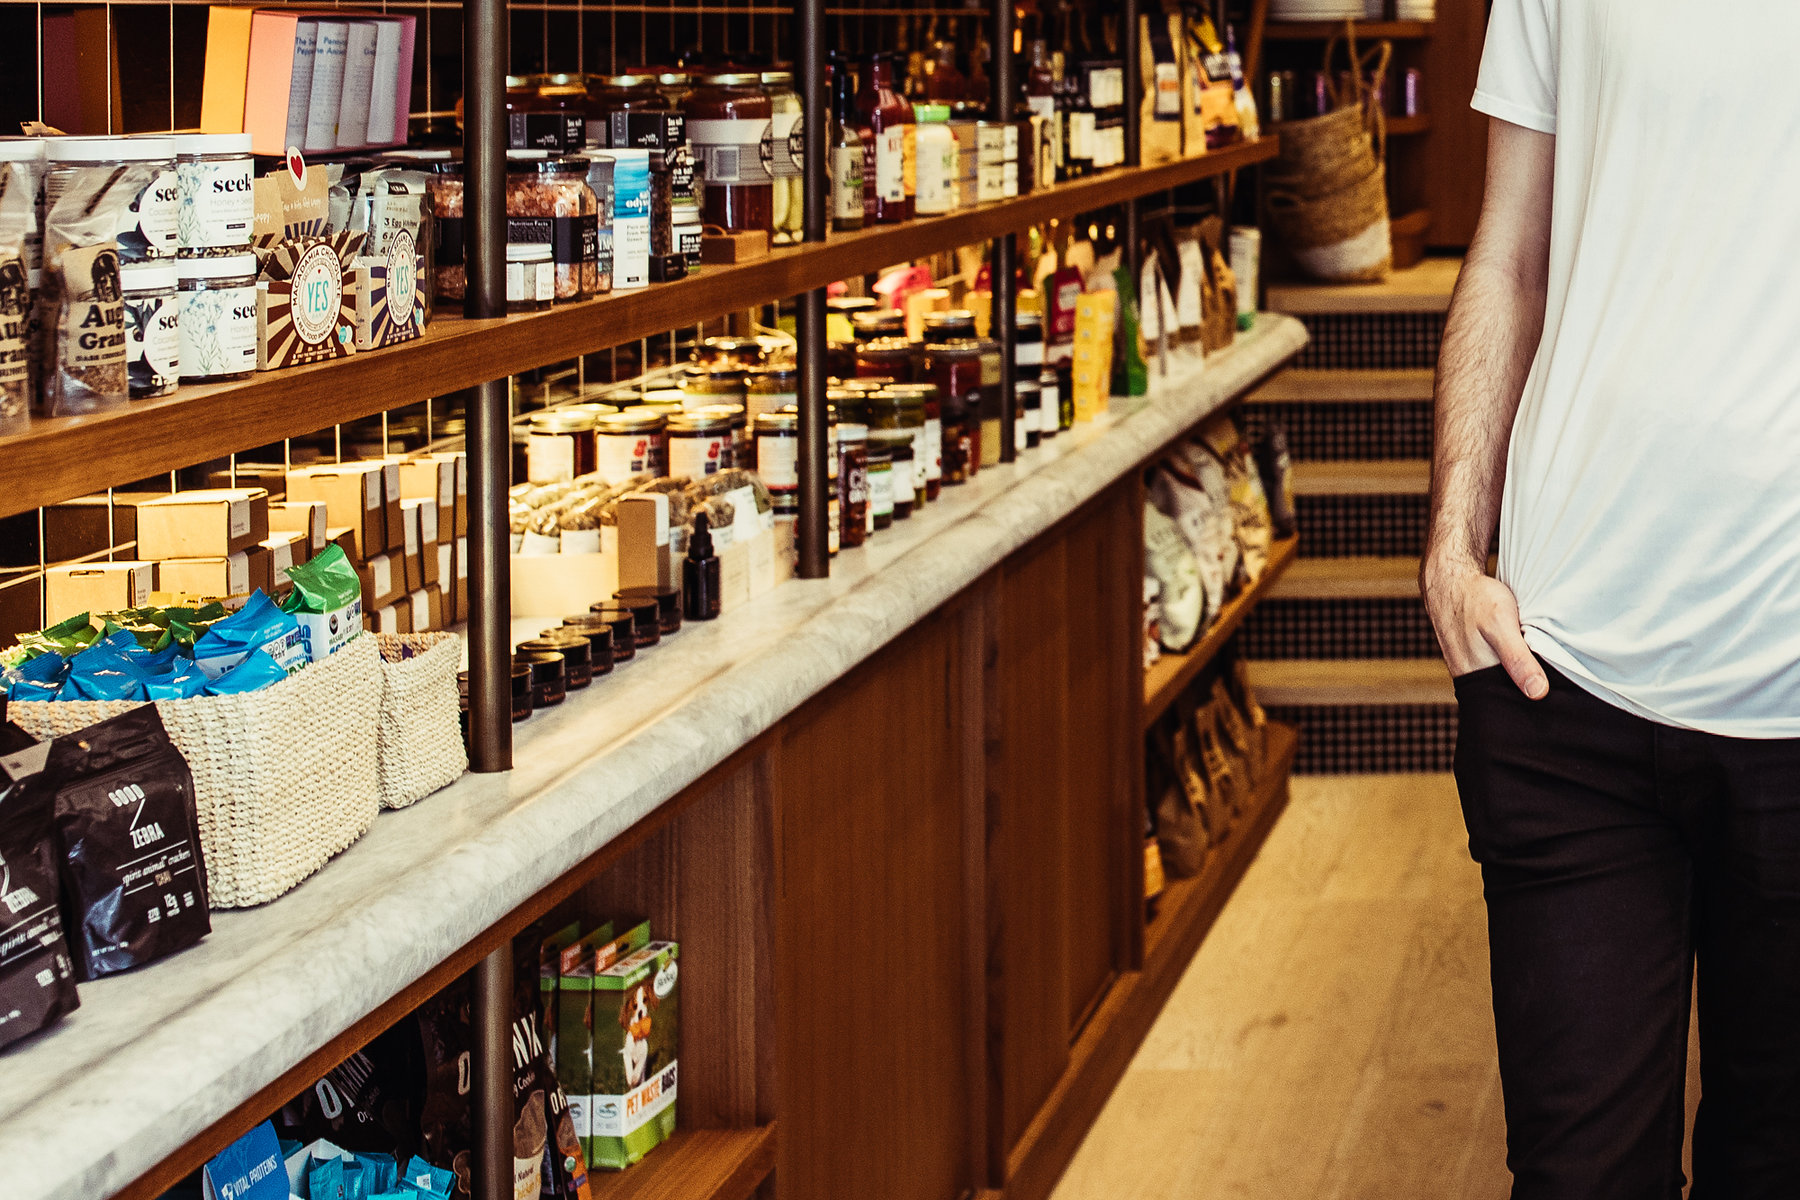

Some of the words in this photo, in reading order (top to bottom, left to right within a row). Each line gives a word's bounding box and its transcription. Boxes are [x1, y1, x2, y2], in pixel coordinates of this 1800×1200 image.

[155, 185, 178, 203] see
[212, 172, 252, 194] seek
[384, 217, 390, 226] 3
[382, 231, 388, 240] 6
[292, 250, 321, 307] MACADAMIA
[320, 249, 341, 300] CHOCOLATE
[395, 264, 410, 297] YES
[307, 279, 330, 313] YES
[79, 303, 124, 330] Aug
[158, 314, 179, 331] see
[232, 302, 257, 321] see
[78, 332, 126, 351] Gran
[108, 783, 146, 807] GOOD
[129, 821, 165, 850] ZEBRA
[626, 1095, 640, 1119] PET
[640, 1079, 661, 1109] WASTE
[661, 1064, 677, 1094] BAGS
[232, 1172, 251, 1198] VITAL
[248, 1153, 278, 1188] PROTEINS
